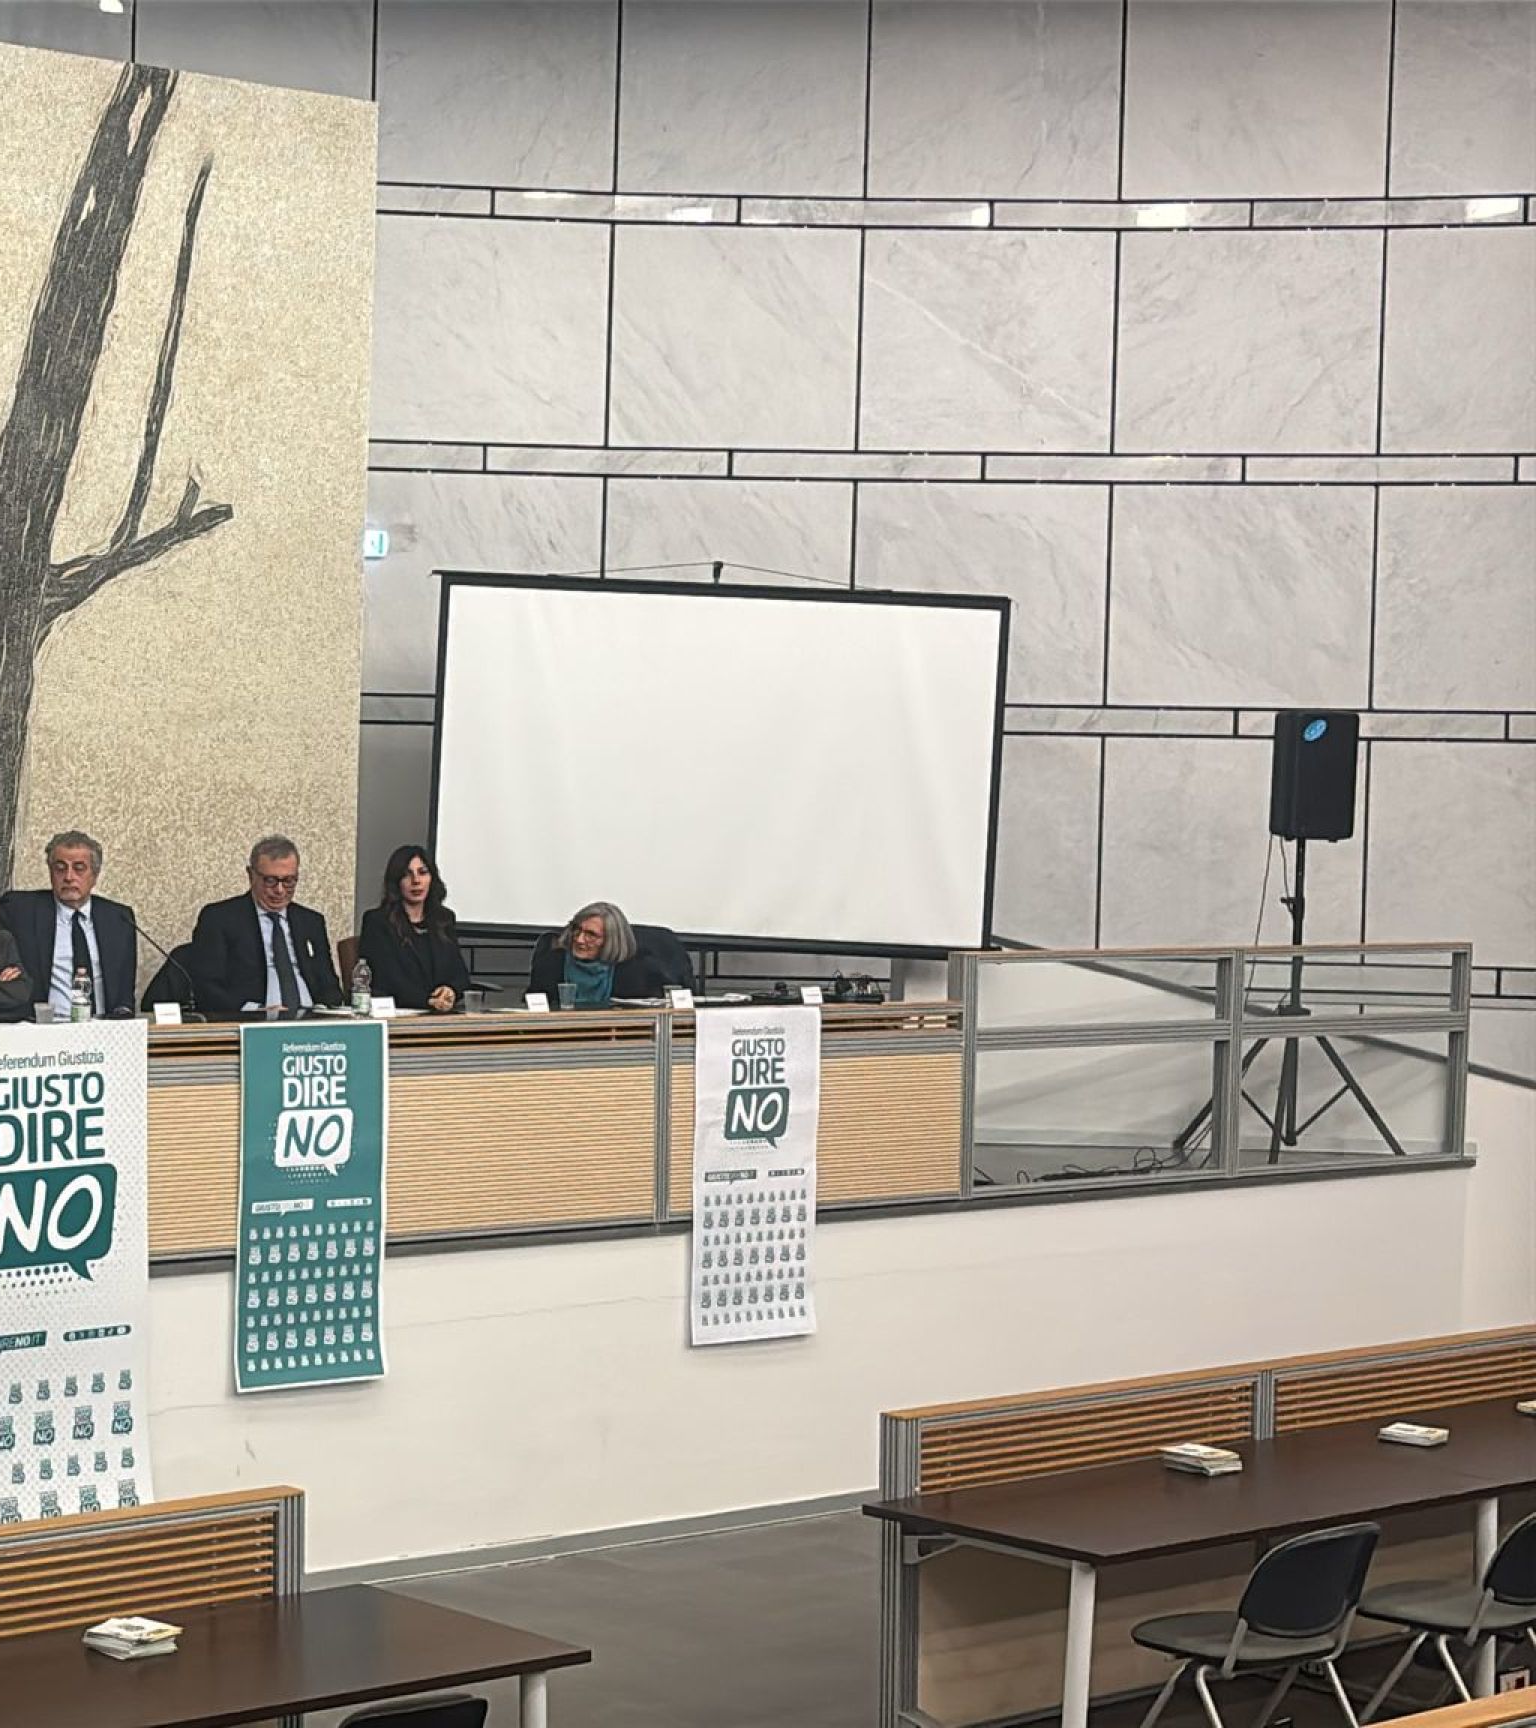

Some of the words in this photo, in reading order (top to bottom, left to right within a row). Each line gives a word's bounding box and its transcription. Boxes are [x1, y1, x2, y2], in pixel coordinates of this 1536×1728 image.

[732, 1038, 785, 1056] GIUSTO
[58, 1050, 104, 1065] Giustizia
[283, 1055, 347, 1075] GIUSTO
[732, 1058, 785, 1086] DIRE
[283, 1076, 347, 1107] DIRE
[731, 1092, 783, 1132] NO
[284, 1114, 344, 1158] NO
[75, 1426, 91, 1437] NO
[113, 1420, 130, 1431] NO
[35, 1431, 53, 1442] NO
